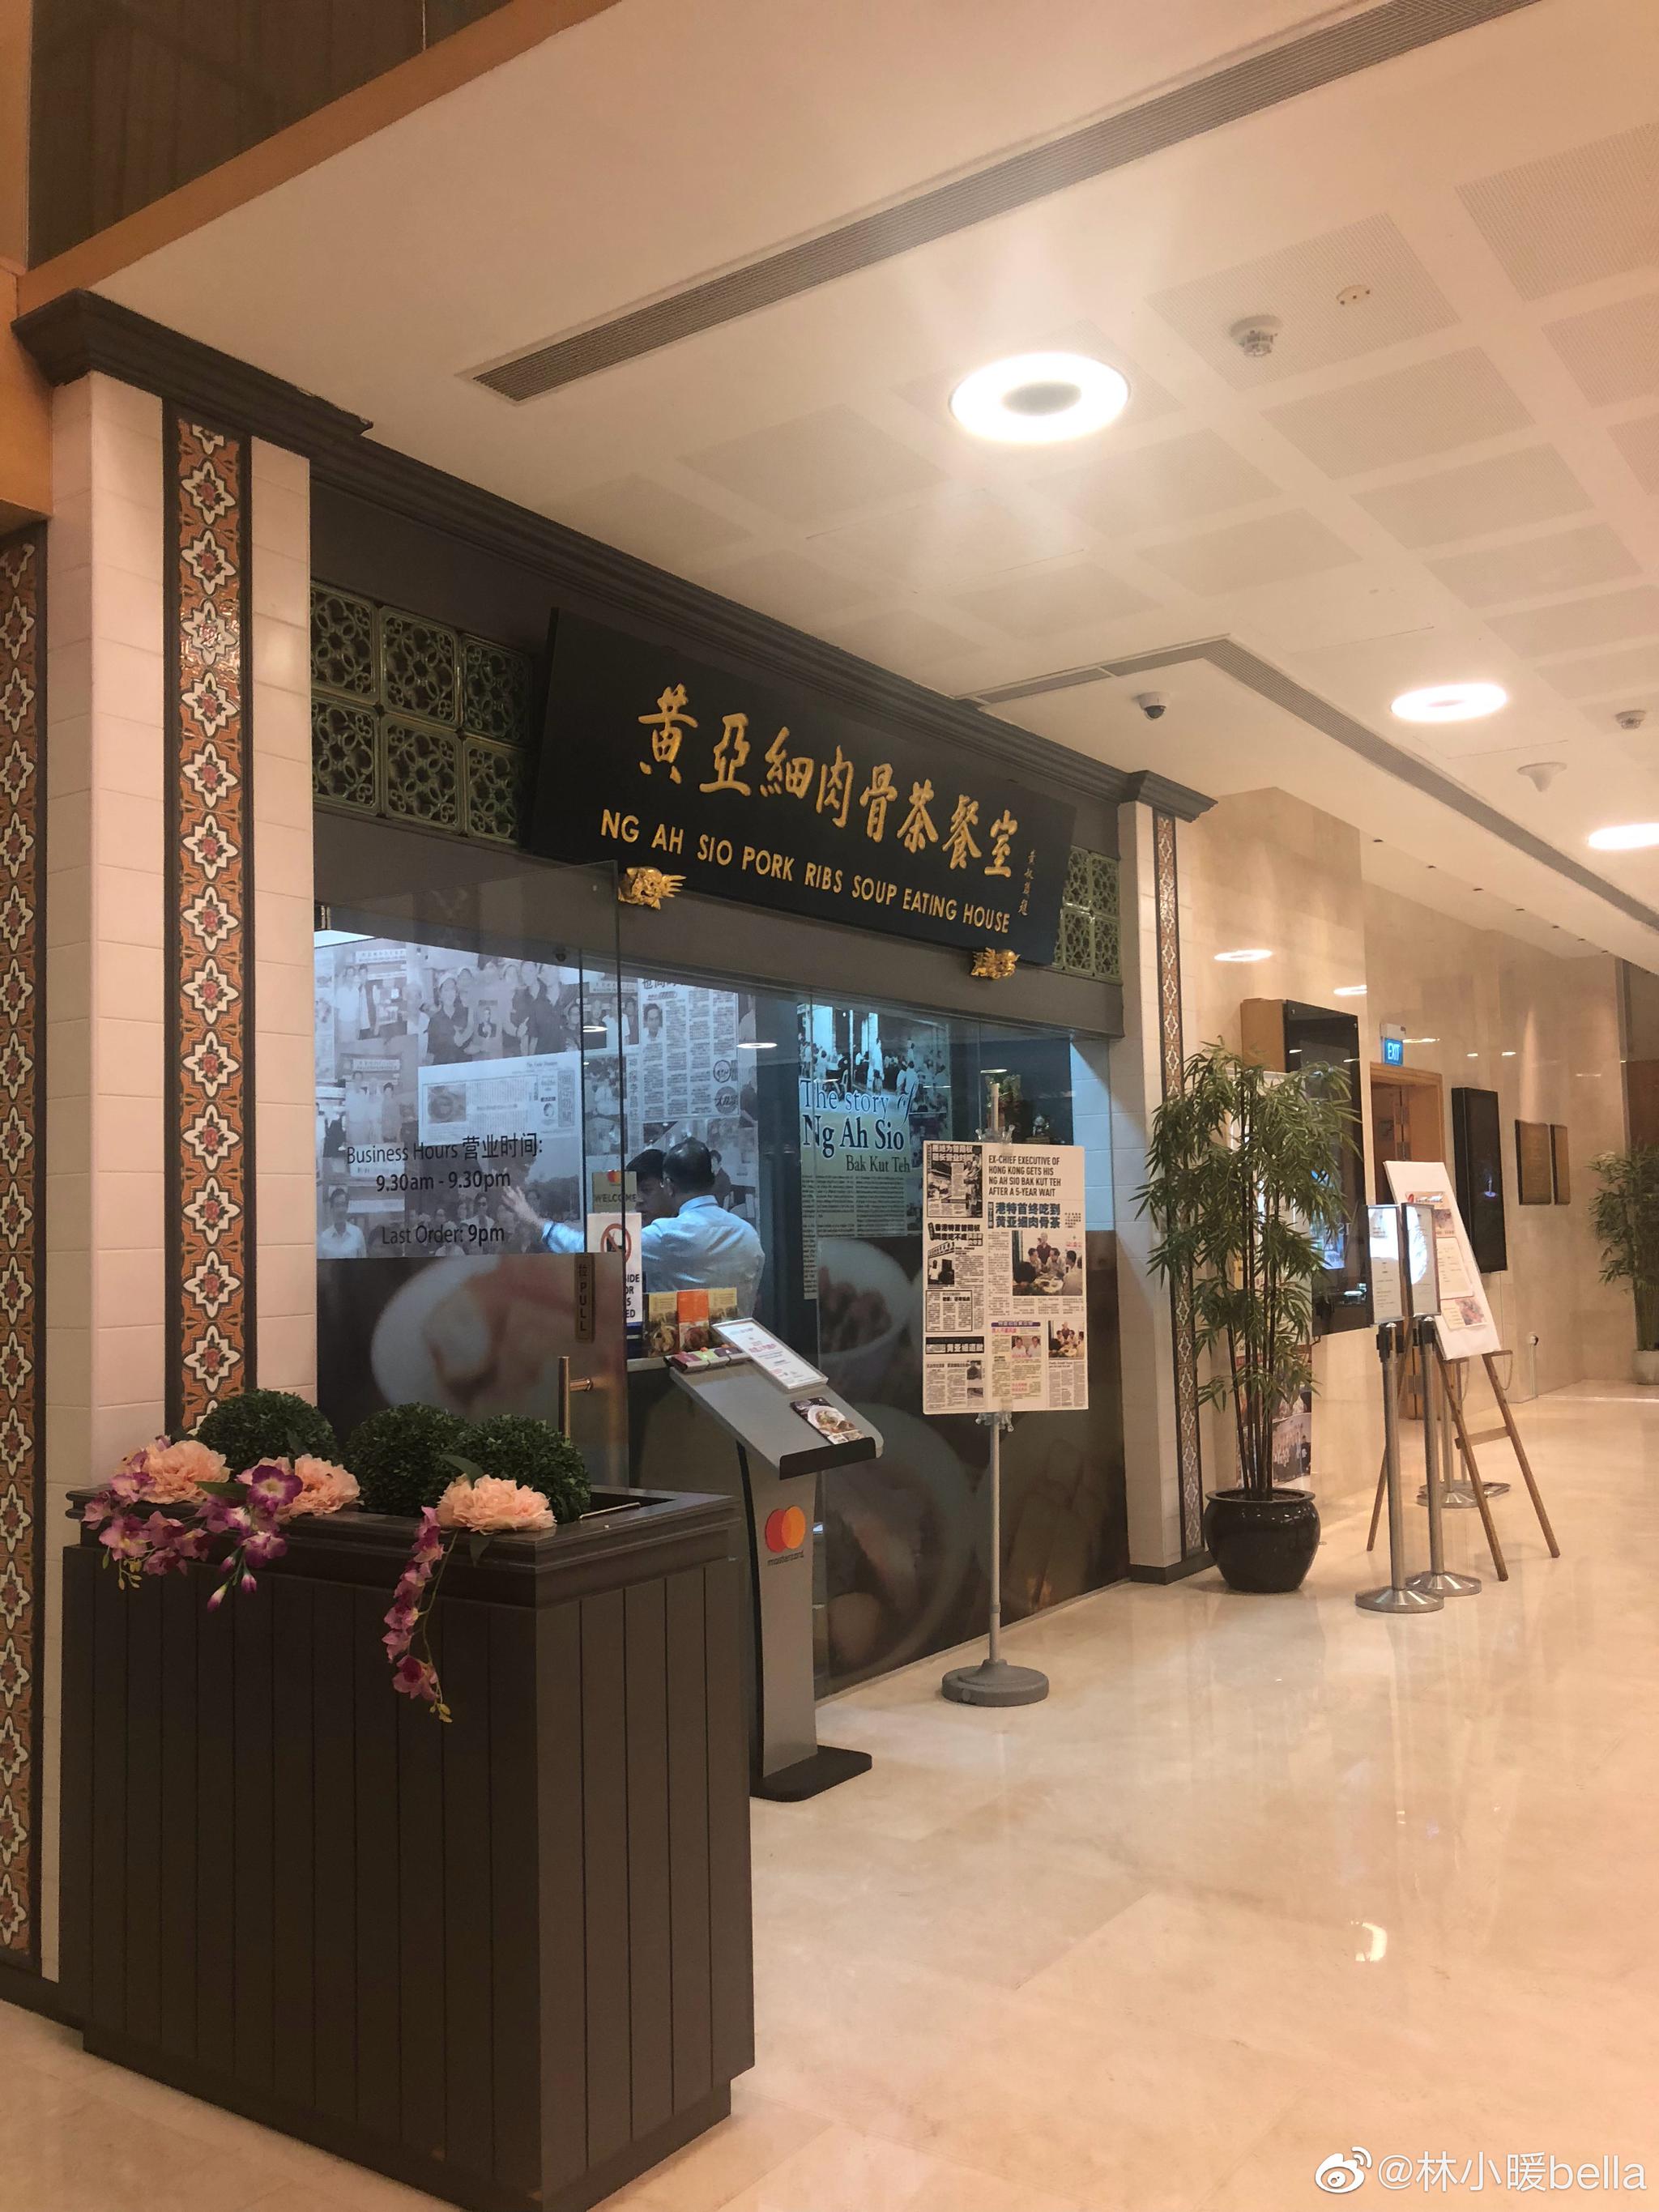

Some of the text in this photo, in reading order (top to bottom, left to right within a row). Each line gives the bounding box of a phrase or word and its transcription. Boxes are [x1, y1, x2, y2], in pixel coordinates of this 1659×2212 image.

[601, 809, 1010, 933] NG AH SIO PORK RIBS SOUP EATING HOUSE
[1388, 1042, 1400, 1061] EXIT
[800, 1080, 838, 1110] The
[845, 1089, 889, 1119] story
[803, 1115, 904, 1158] Ng Ah Sio
[347, 1146, 408, 1164] Business
[413, 1142, 458, 1161] Hours
[988, 1155, 1060, 1166] EX-CHIEF EXECUTIVE OF
[846, 1154, 867, 1171] Bak
[869, 1156, 889, 1172] Kut
[891, 1157, 910, 1173] Teh
[988, 1166, 1006, 1174] HONG
[1008, 1166, 1025, 1174] KONG
[1026, 1167, 1042, 1175] GETS
[376, 1174, 434, 1192] 9.30am
[449, 1171, 511, 1192] 9.30pm
[988, 1177, 1061, 1186] NG AH SIO BAK KUT TEH
[988, 1187, 1056, 1196] AFTER A 5-YEAR WAIT
[382, 1224, 505, 1247] Last Order: 9pm
